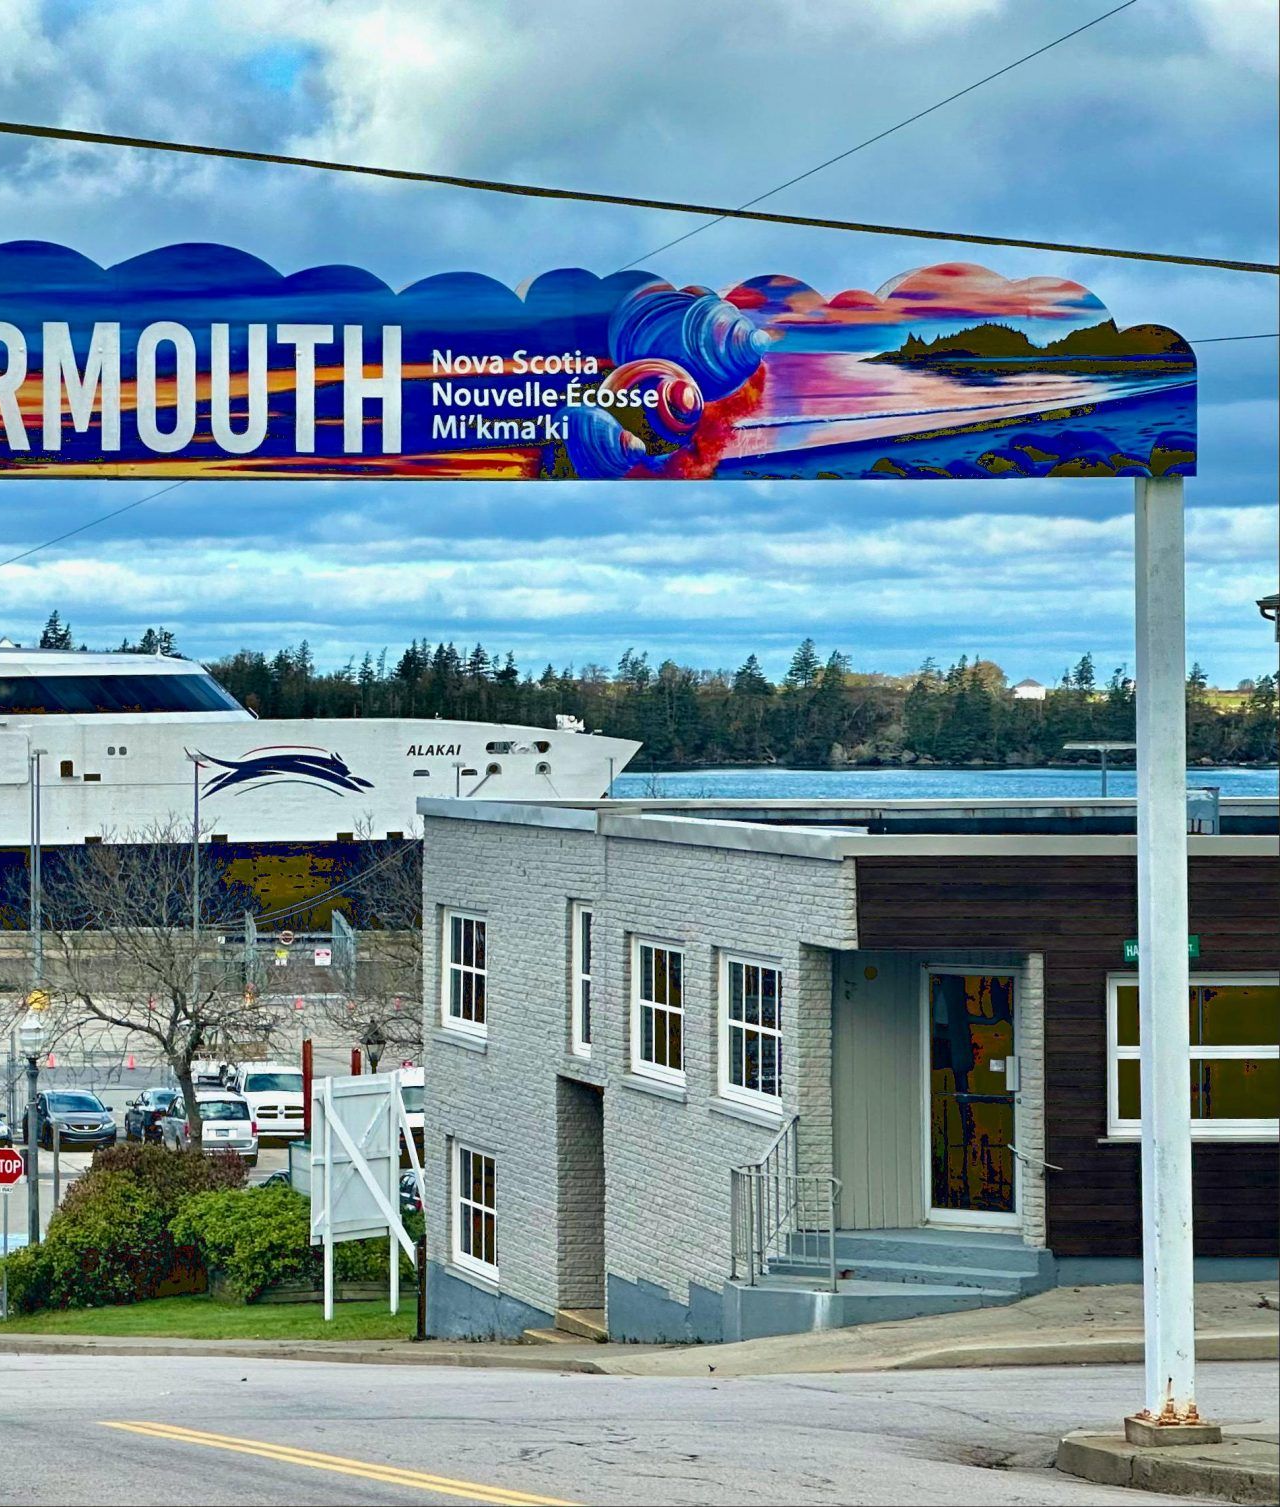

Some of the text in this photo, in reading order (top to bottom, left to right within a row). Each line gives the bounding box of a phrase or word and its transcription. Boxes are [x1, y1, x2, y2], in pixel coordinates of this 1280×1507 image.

[432, 349, 598, 375] Nova Scotia
[432, 377, 659, 408] Nouvelle-Écosse
[407, 744, 462, 756] ALAKAI
